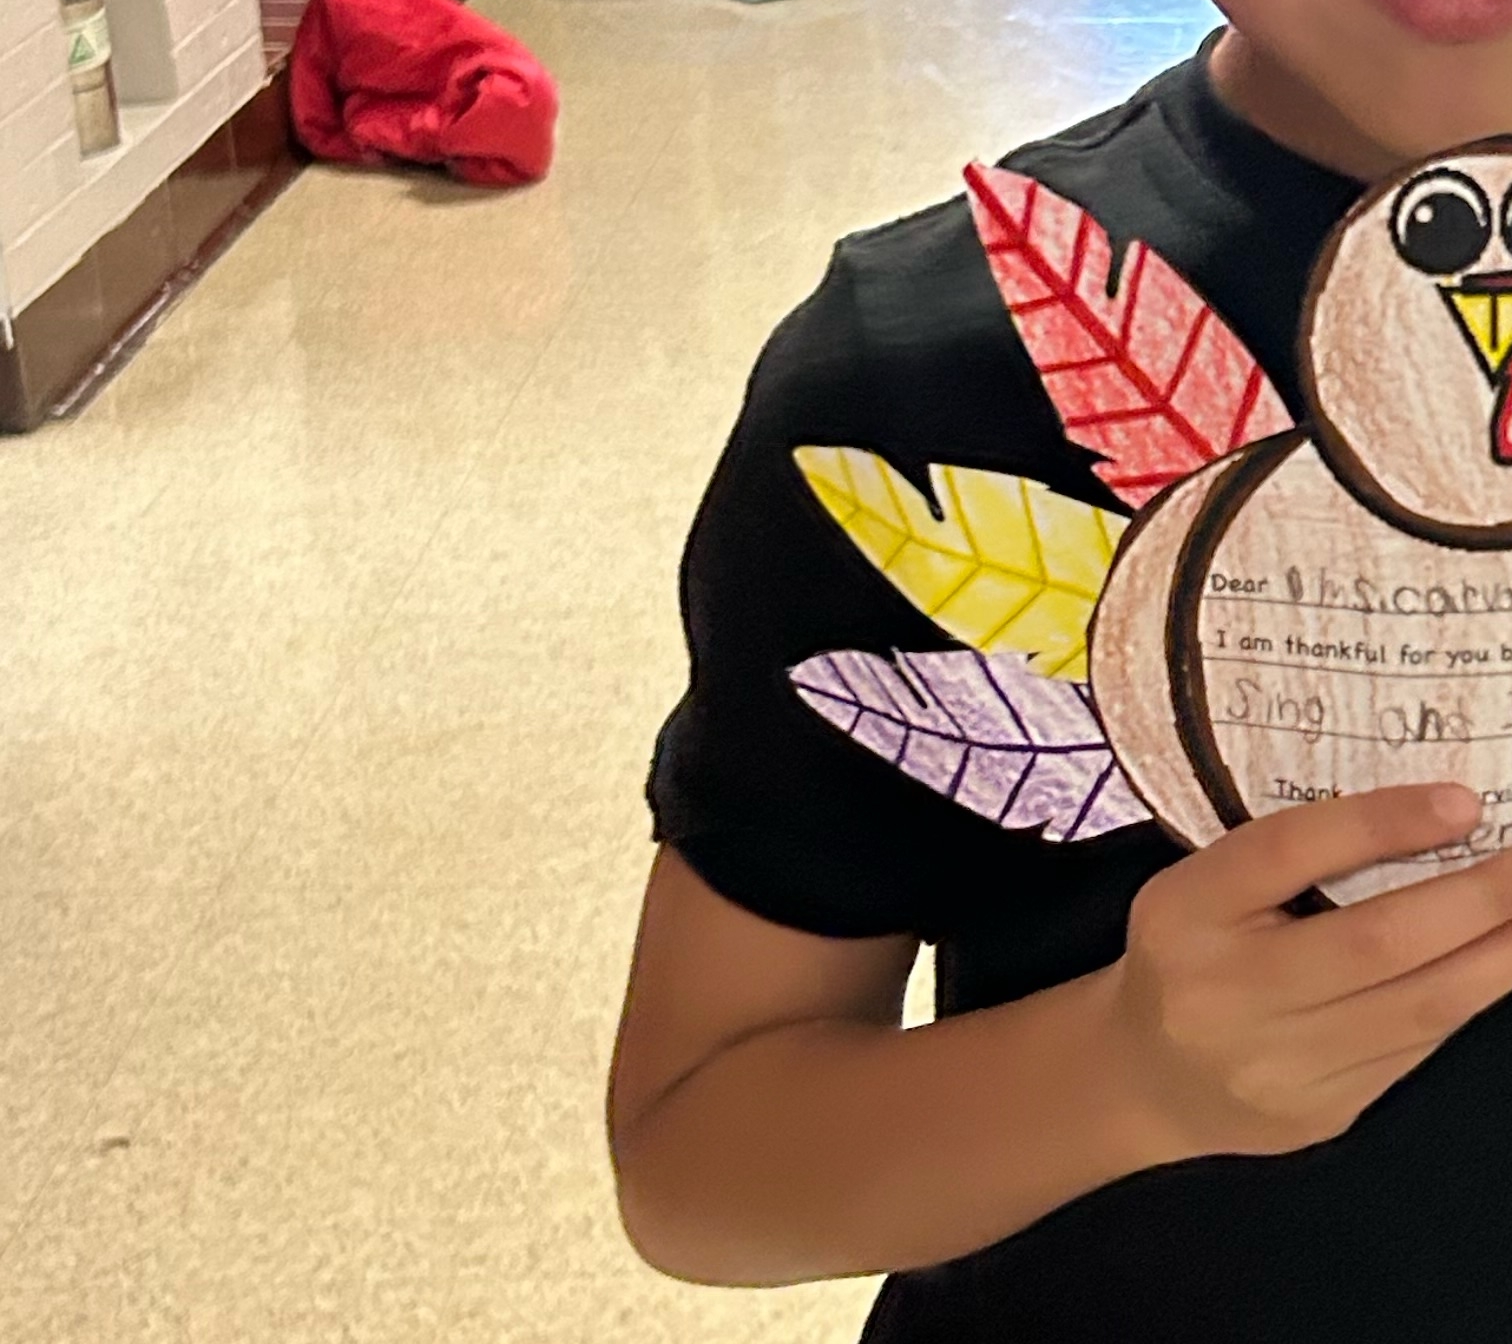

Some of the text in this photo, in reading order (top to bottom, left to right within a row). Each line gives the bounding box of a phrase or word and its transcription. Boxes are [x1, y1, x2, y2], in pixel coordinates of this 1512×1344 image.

[1211, 573, 1269, 593] Dear
[1216, 629, 1227, 648] I
[1239, 635, 1273, 652] am
[1285, 635, 1386, 663] thankful
[1400, 643, 1433, 664] for
[1446, 649, 1489, 668] you
